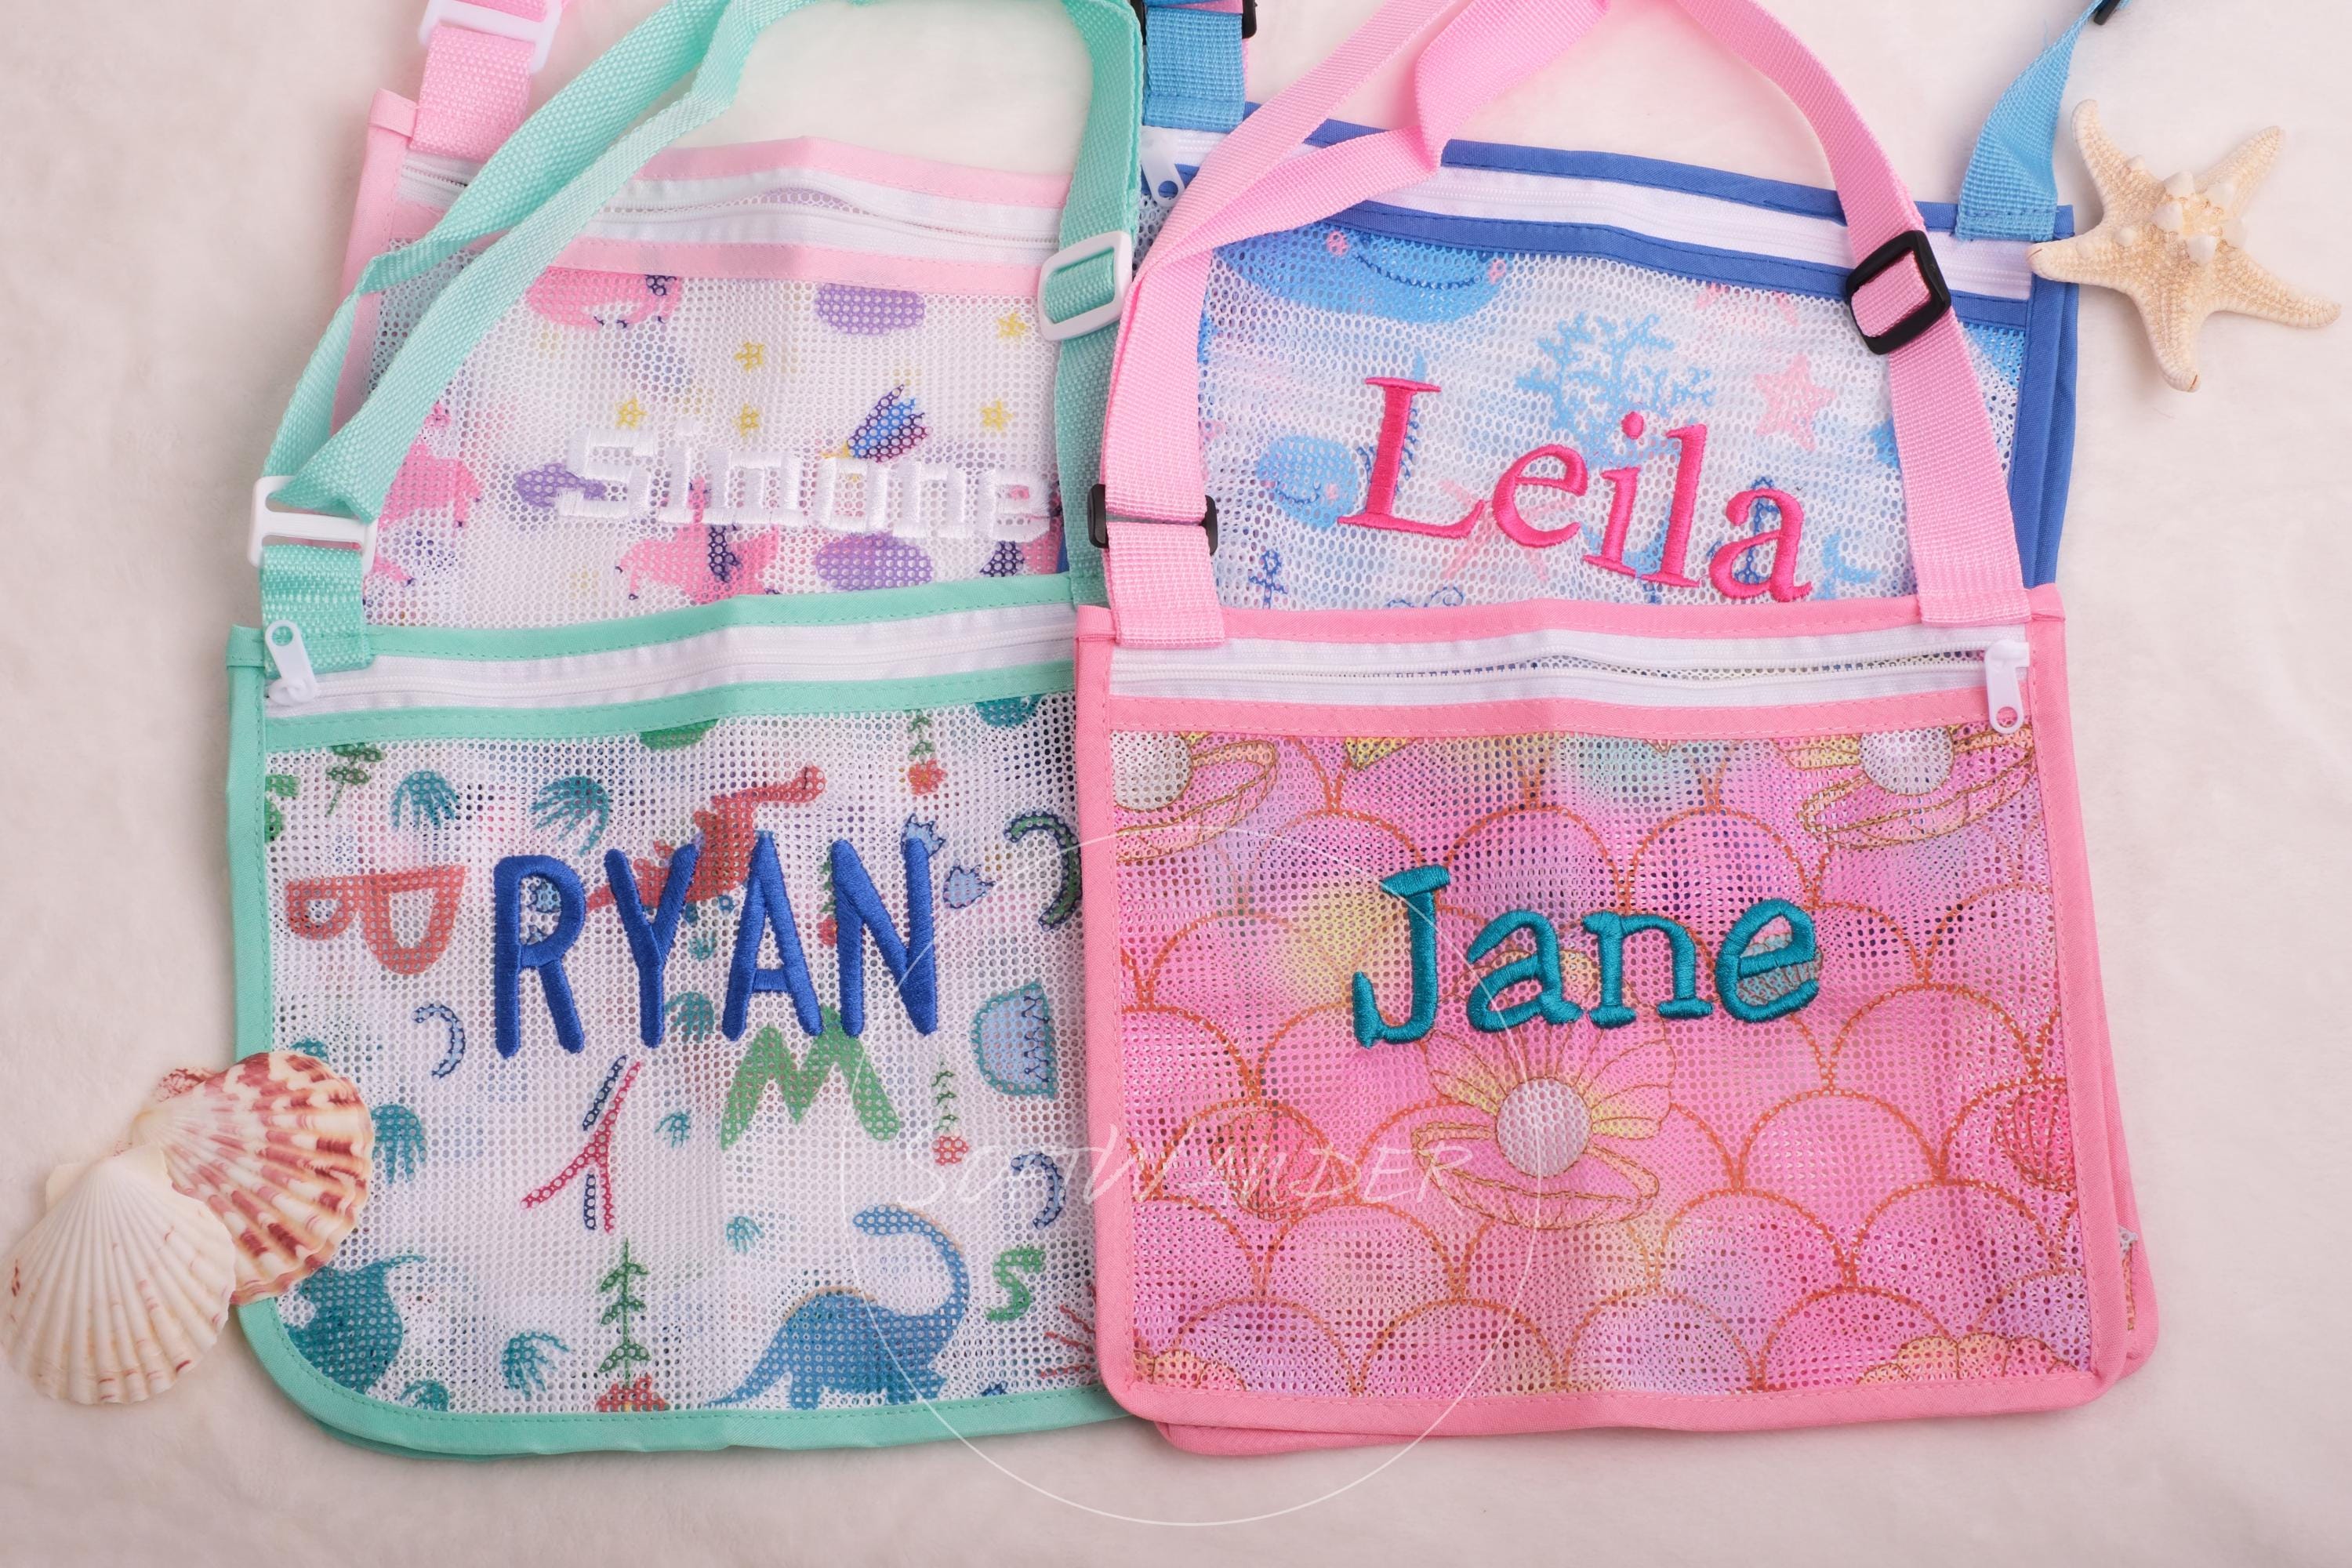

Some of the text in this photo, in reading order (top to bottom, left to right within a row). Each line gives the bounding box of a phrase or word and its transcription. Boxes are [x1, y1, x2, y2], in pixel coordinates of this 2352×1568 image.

[554, 417, 1051, 543] Simone
[1338, 376, 1813, 602] Leila
[492, 829, 938, 1059] RYAN
[1352, 864, 1820, 1049] Jane
